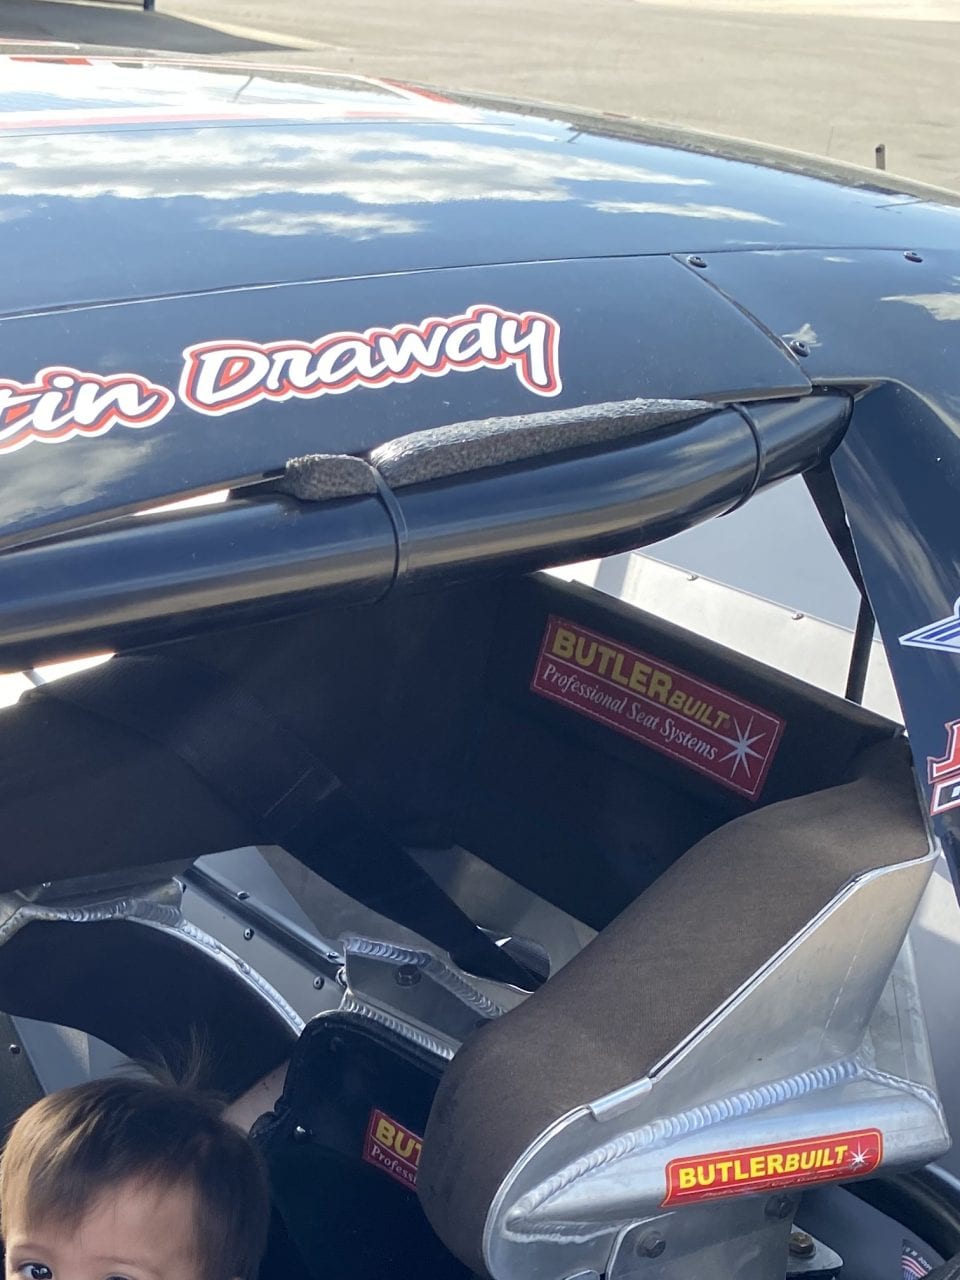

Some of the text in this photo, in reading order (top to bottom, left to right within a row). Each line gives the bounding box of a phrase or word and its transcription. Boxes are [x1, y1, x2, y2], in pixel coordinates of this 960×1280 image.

[182, 306, 560, 414] Drawdy
[543, 664, 718, 761] Professional Seat Systems
[551, 627, 730, 729] BUTLERBUILT
[679, 1146, 848, 1189] BUTLERBUILT
